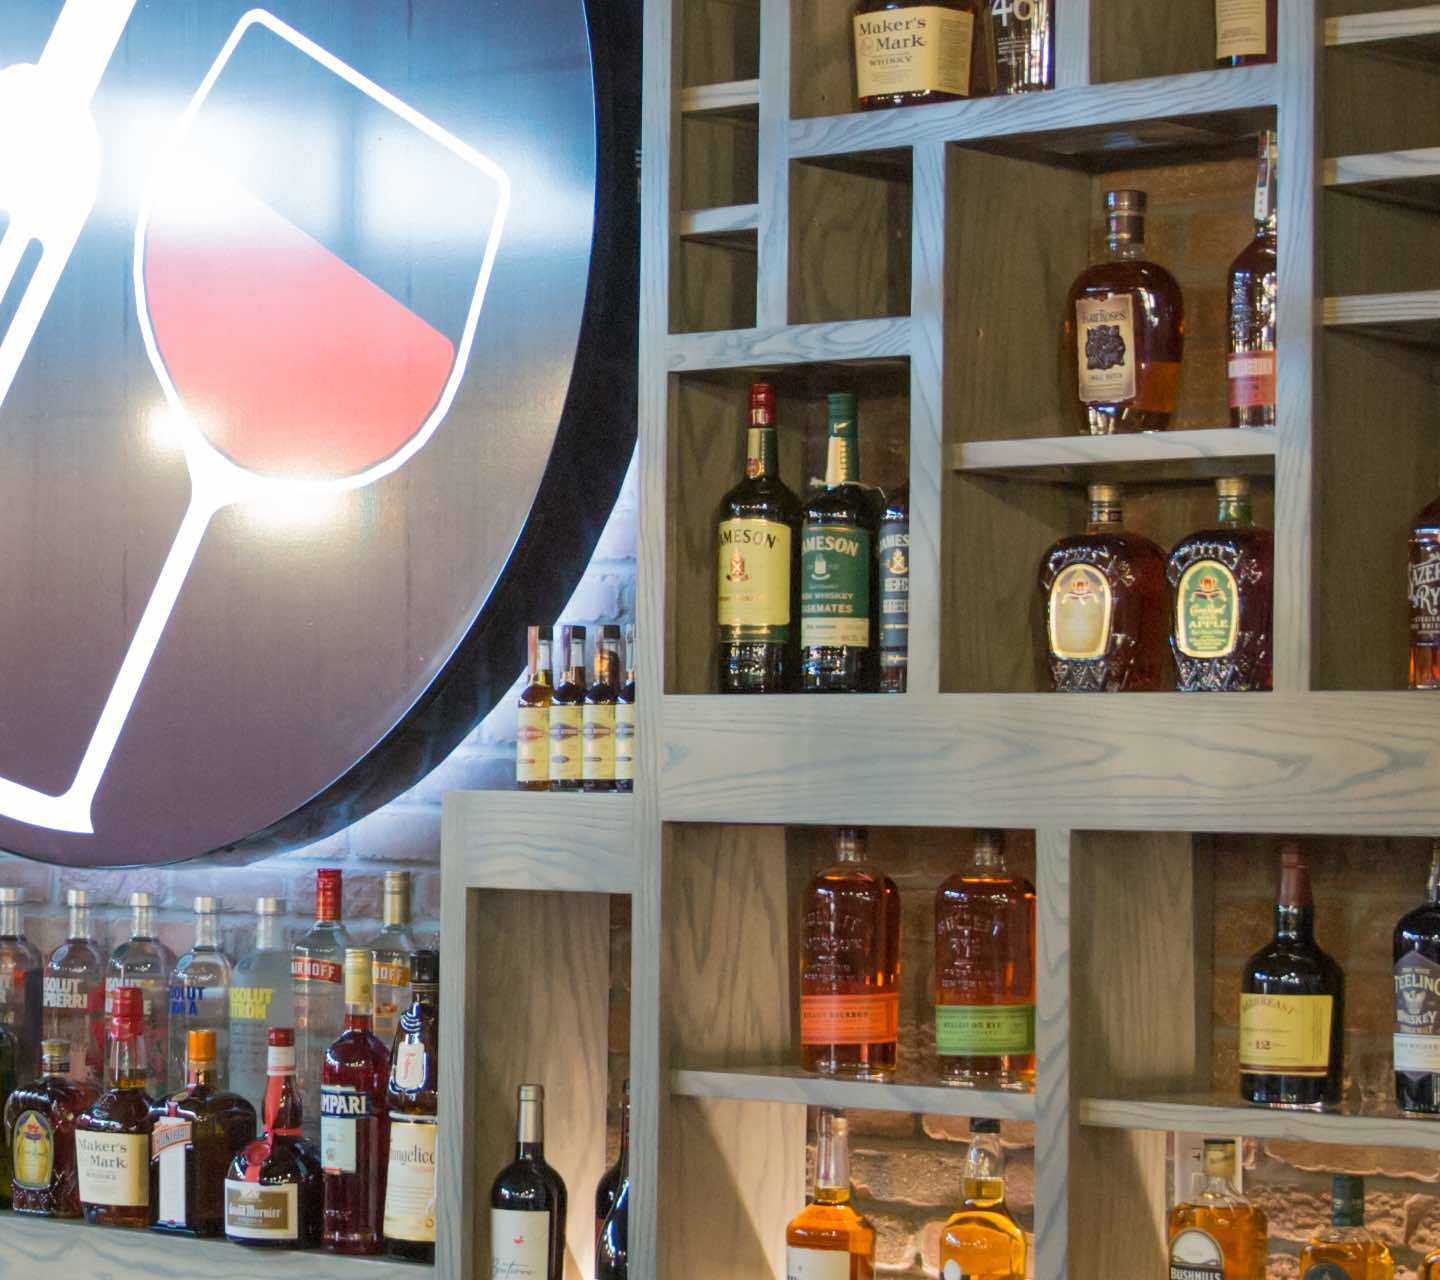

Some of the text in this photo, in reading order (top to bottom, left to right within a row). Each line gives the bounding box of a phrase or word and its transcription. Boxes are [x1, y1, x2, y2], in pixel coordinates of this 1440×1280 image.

[860, 17, 926, 35] Maker's
[876, 34, 926, 51] Mark
[720, 529, 777, 550] AMESON
[802, 535, 859, 557] AMESON
[880, 534, 909, 552] AMES
[291, 961, 336, 979] IRNOFF
[373, 965, 403, 979] NOFF
[43, 977, 81, 993] SOLUT
[170, 986, 205, 1001] SOLUT
[43, 992, 88, 1008] PBERRI
[229, 987, 273, 1003] SOLUT
[321, 1094, 367, 1115] MPARI
[77, 1137, 128, 1154] Maker's
[89, 1153, 128, 1169] Mark
[391, 1144, 435, 1165] ngelic
